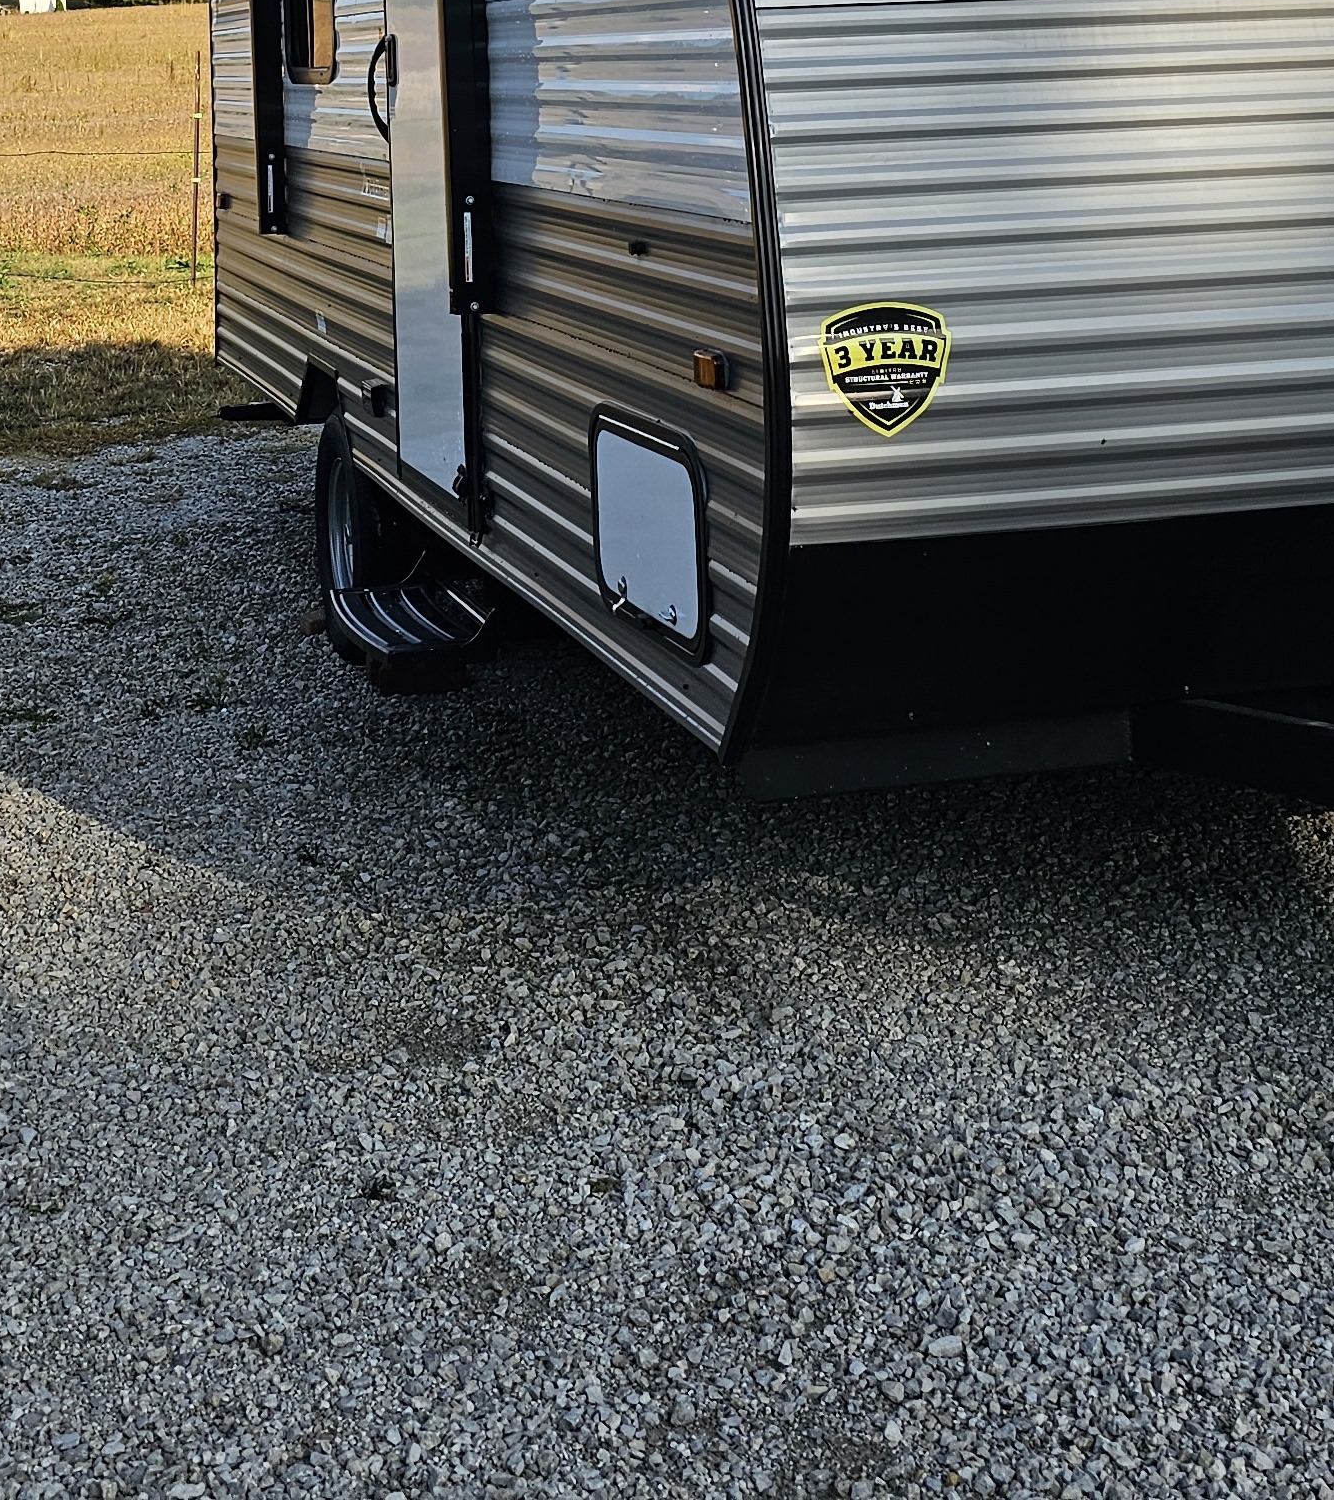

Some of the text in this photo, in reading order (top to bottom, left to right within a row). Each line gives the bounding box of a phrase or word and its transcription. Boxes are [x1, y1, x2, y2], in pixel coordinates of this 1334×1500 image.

[834, 338, 938, 369] 3 YEAR
[845, 374, 889, 384] STRUCTURAL
